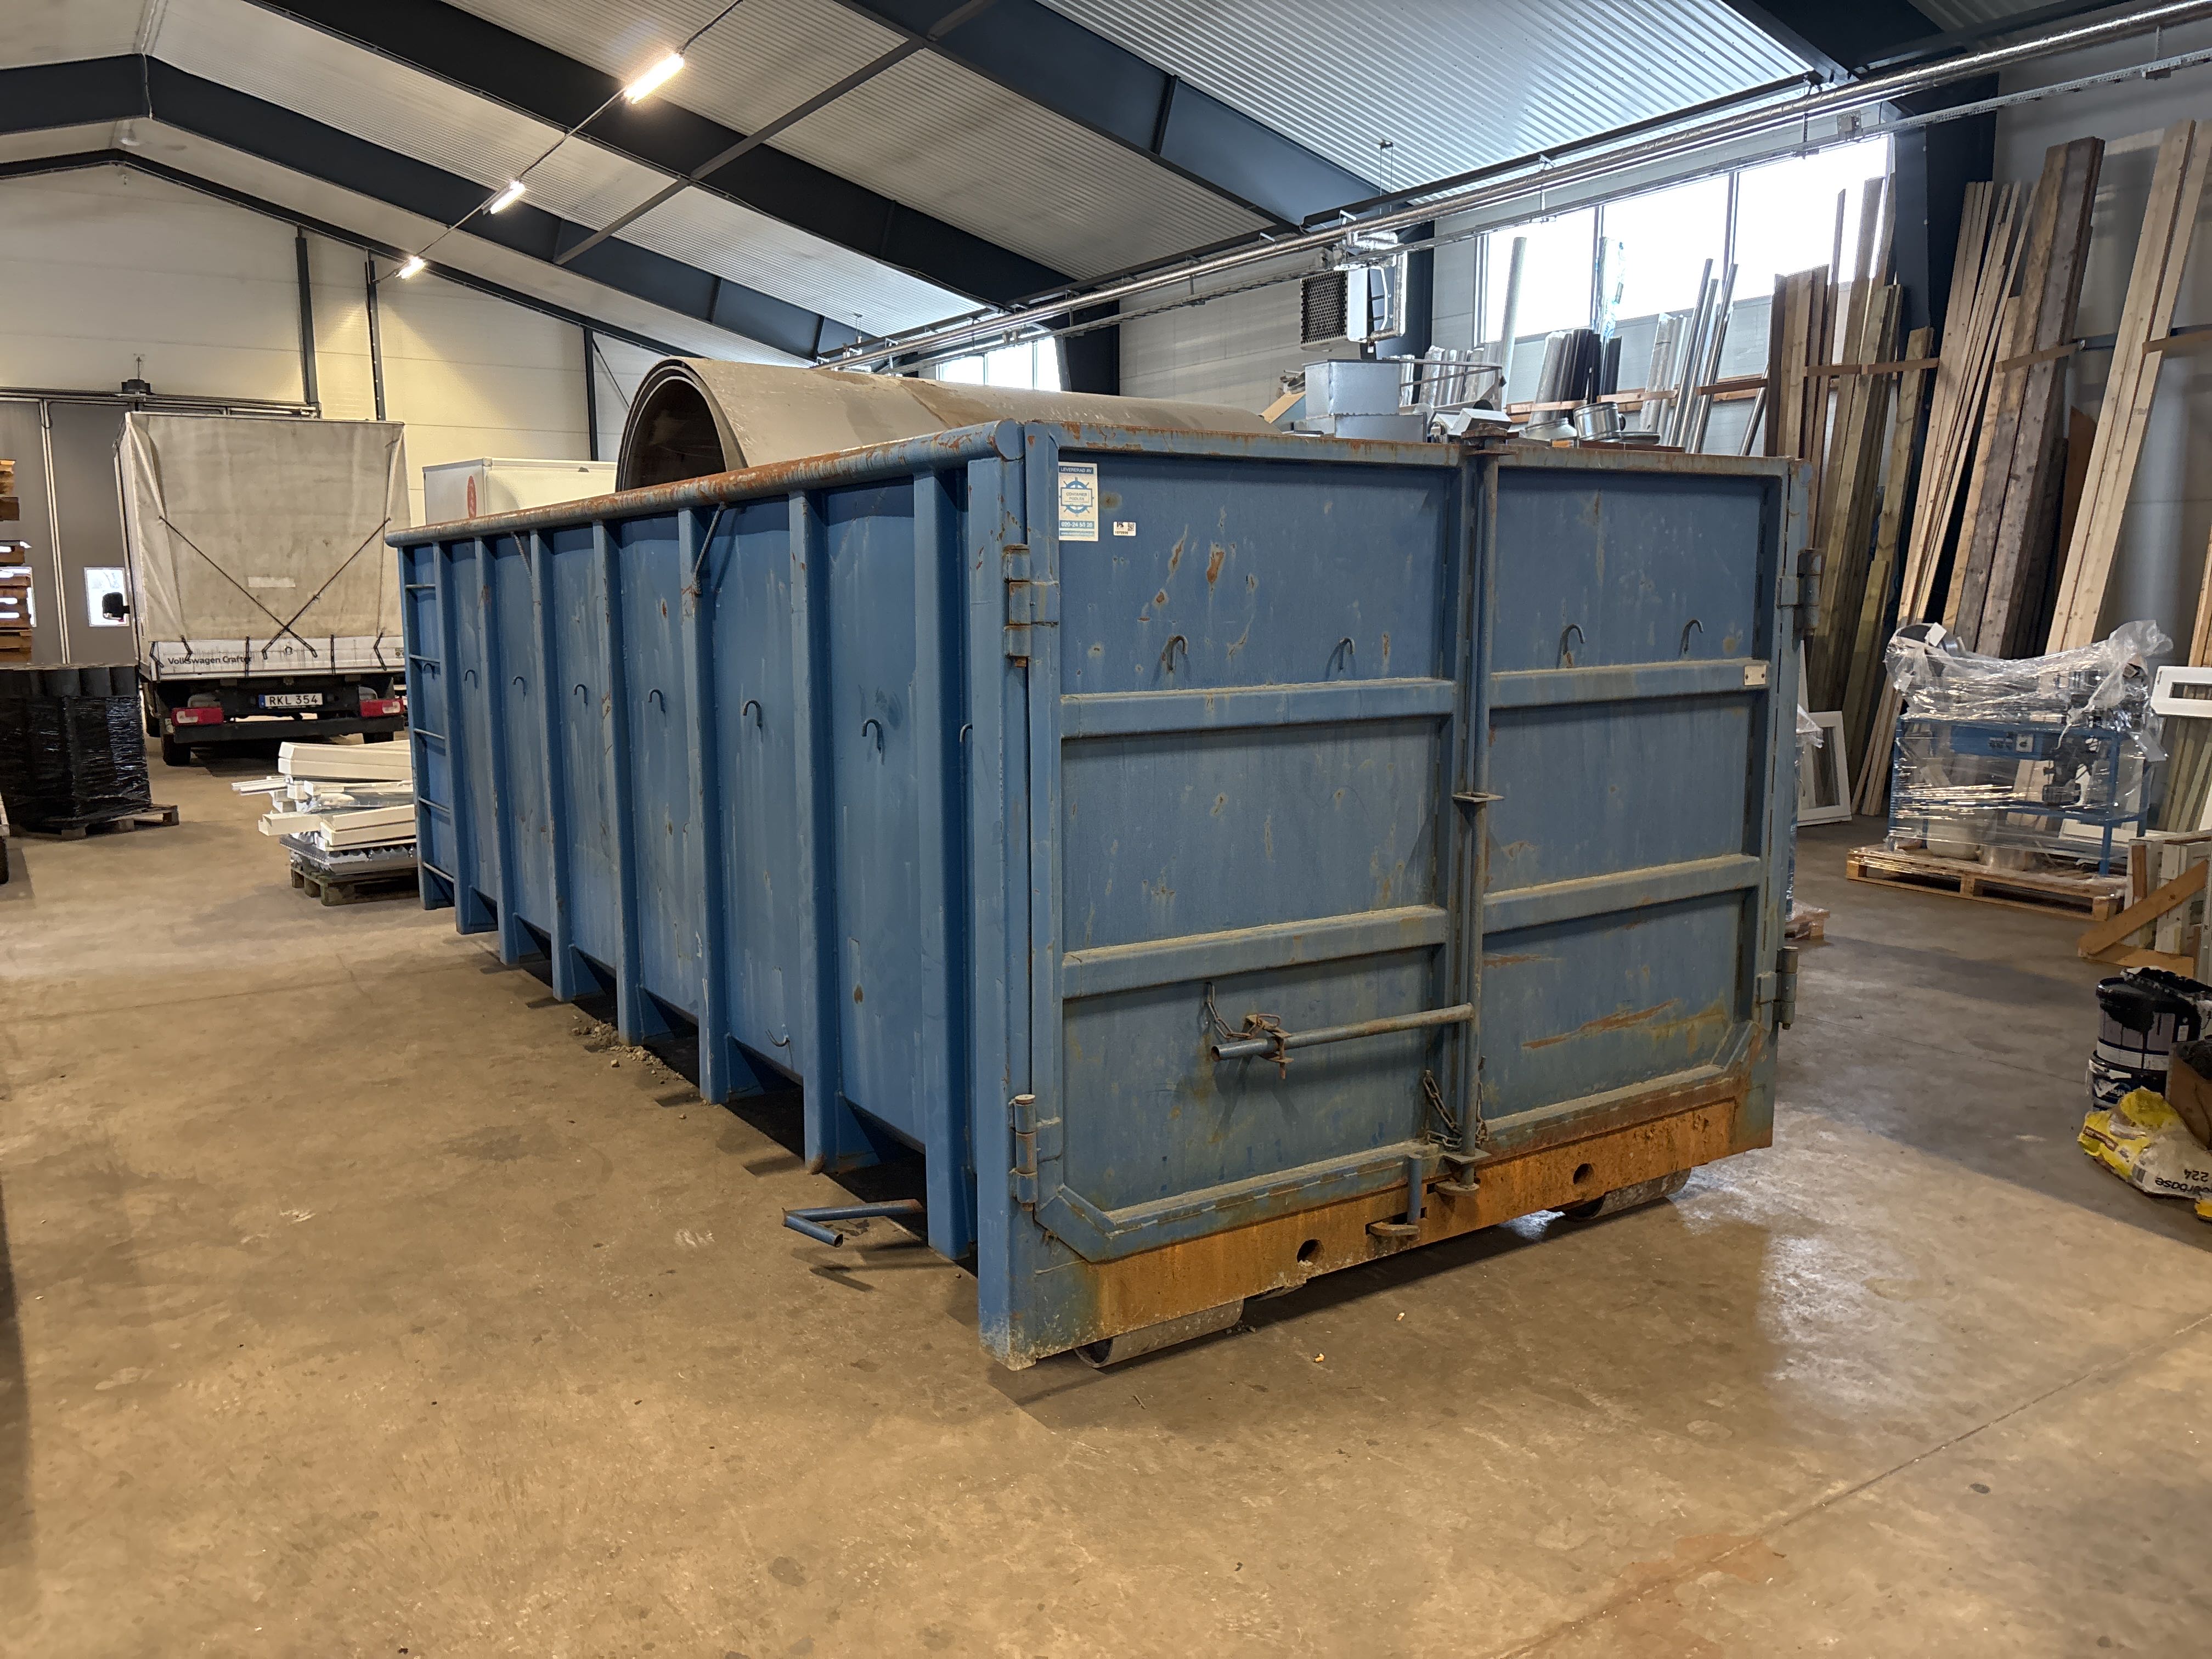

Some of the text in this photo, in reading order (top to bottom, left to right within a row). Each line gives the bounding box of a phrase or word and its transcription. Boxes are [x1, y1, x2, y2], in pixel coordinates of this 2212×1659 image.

[269, 695, 318, 705] RKL 354
[2184, 1169, 2209, 1182] 224
